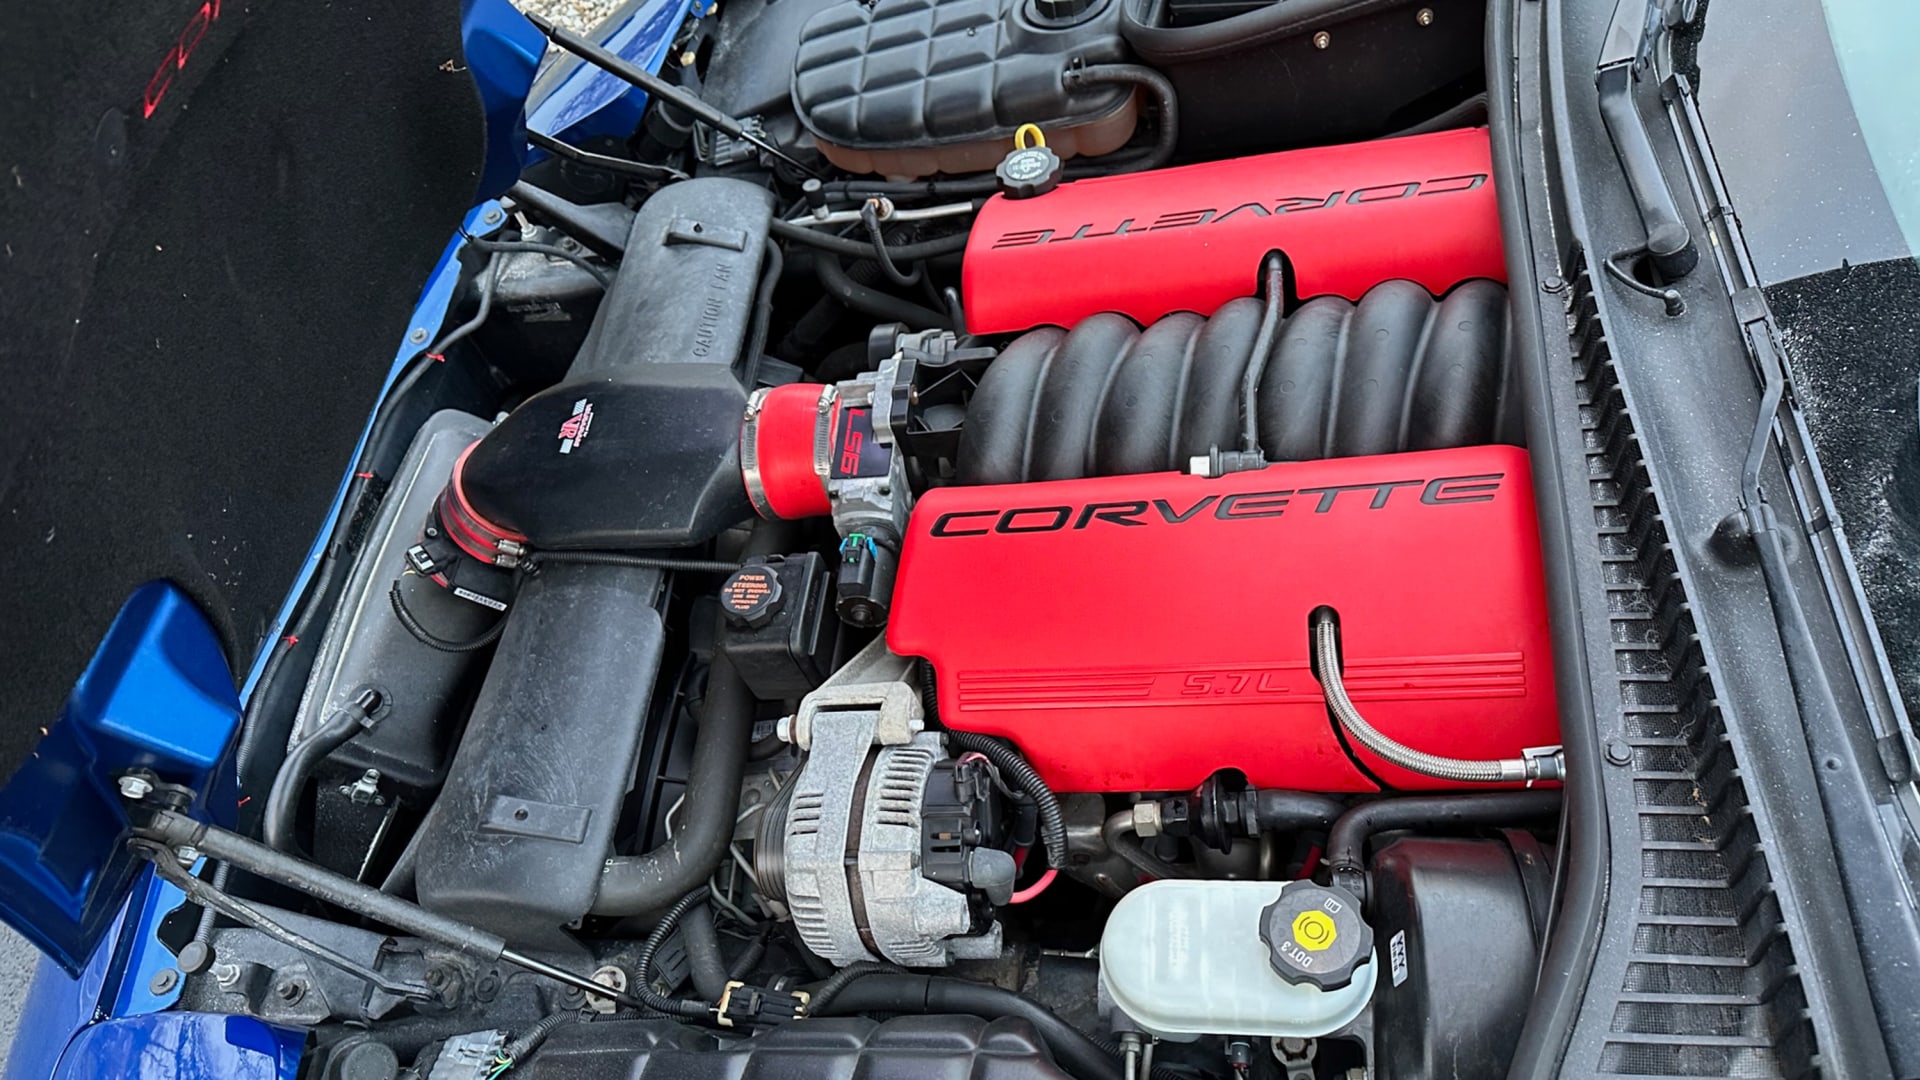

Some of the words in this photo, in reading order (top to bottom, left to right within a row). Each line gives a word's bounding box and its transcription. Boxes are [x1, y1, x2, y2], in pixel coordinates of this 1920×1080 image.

[143, 0, 222, 119] CO
[991, 173, 1488, 249] CORVETTE
[692, 297, 722, 357] CAUTION
[840, 407, 866, 476] LS6
[929, 472, 1505, 538] CORVETTE
[1181, 671, 1290, 696] 5.7L
[1281, 940, 1292, 952] 3
[1288, 947, 1314, 969] DOT
